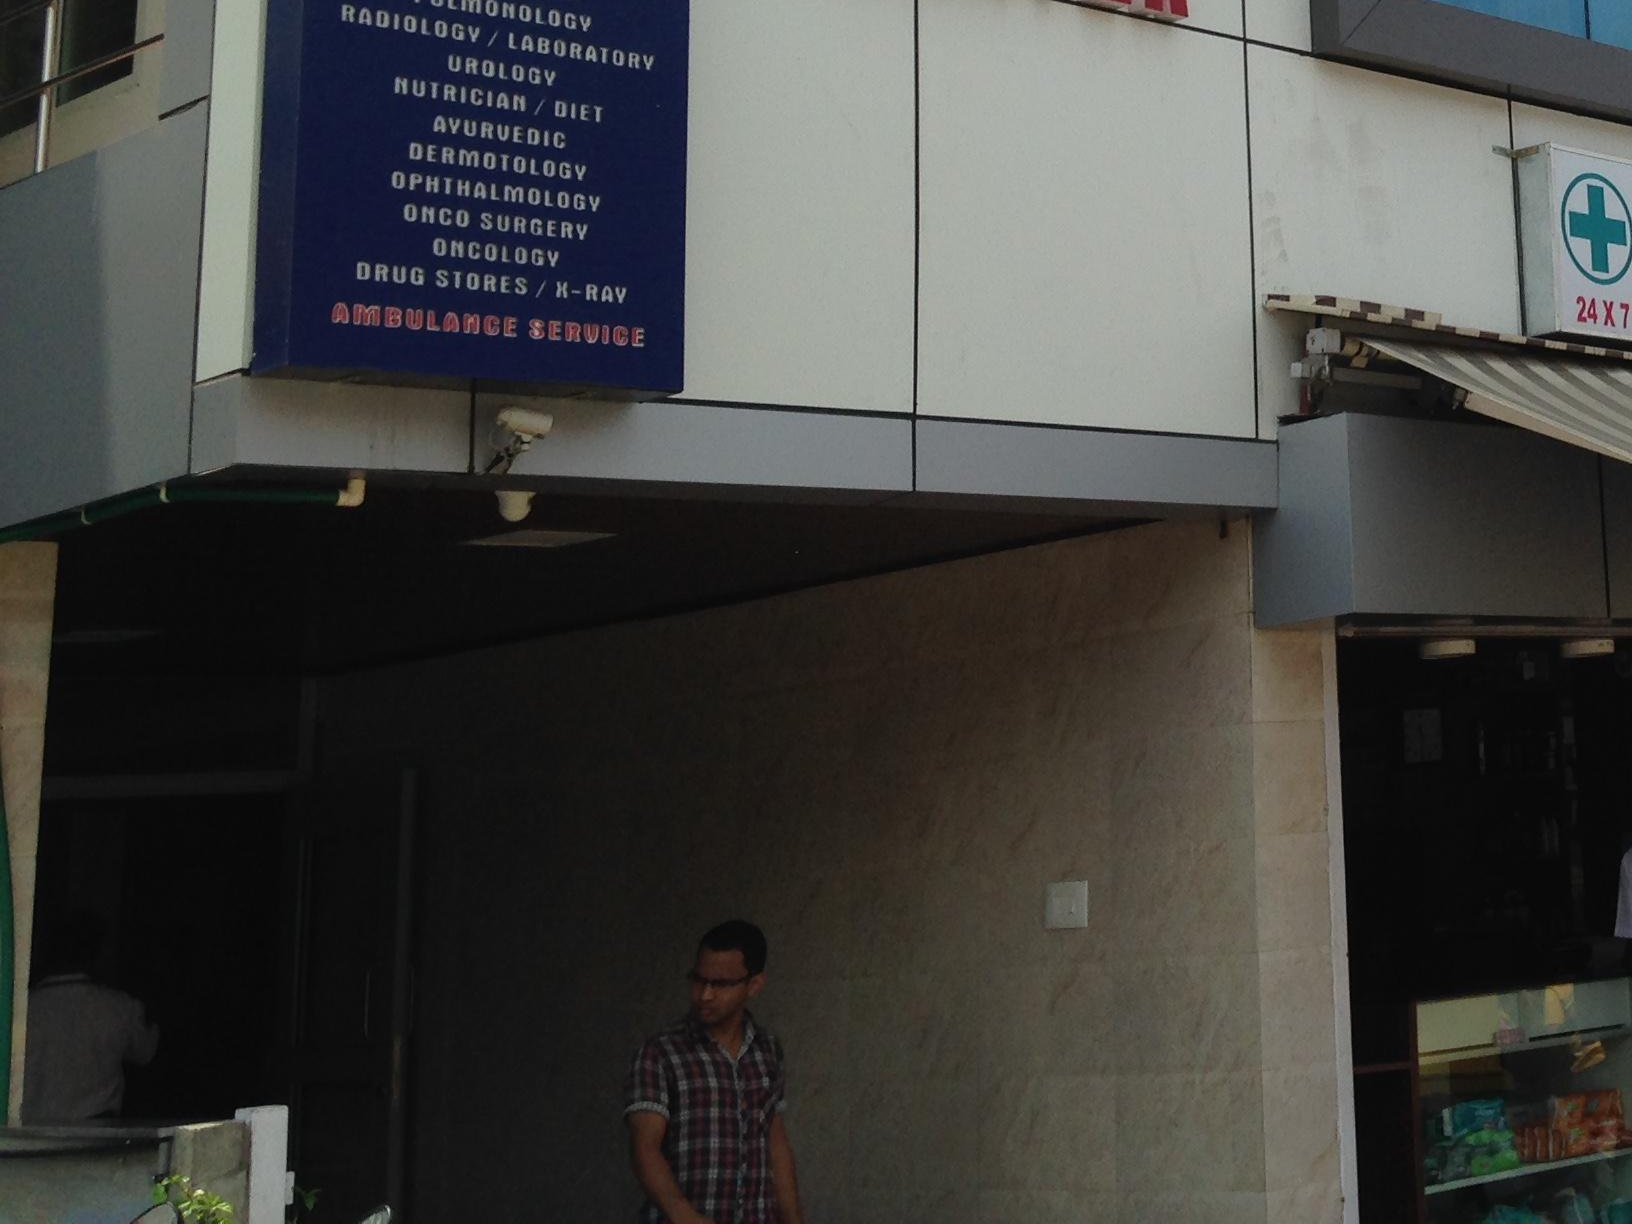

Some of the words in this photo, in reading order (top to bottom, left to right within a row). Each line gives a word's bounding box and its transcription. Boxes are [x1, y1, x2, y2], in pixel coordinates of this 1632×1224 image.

[341, 4, 480, 44] RADIOLOGY
[508, 31, 656, 72] LABORATORY
[448, 54, 557, 87] UROLOGY
[393, 76, 527, 113] NUTRICIAN
[554, 100, 604, 123] DIET
[433, 115, 567, 149] AYURVEDIC
[409, 142, 588, 182] DERMOTOLOGY
[391, 170, 601, 213] OPHTHALMOLOGY
[403, 203, 470, 229] ONCO
[480, 212, 590, 242] SURGERY
[433, 238, 560, 268] ONCOLOGY
[356, 261, 425, 288] DRUG
[435, 270, 528, 297] STORES
[555, 279, 628, 304] X-RAY
[331, 301, 518, 339] AMBULANCE
[529, 318, 645, 348] SERVICE
[1576, 296, 1598, 326] 24
